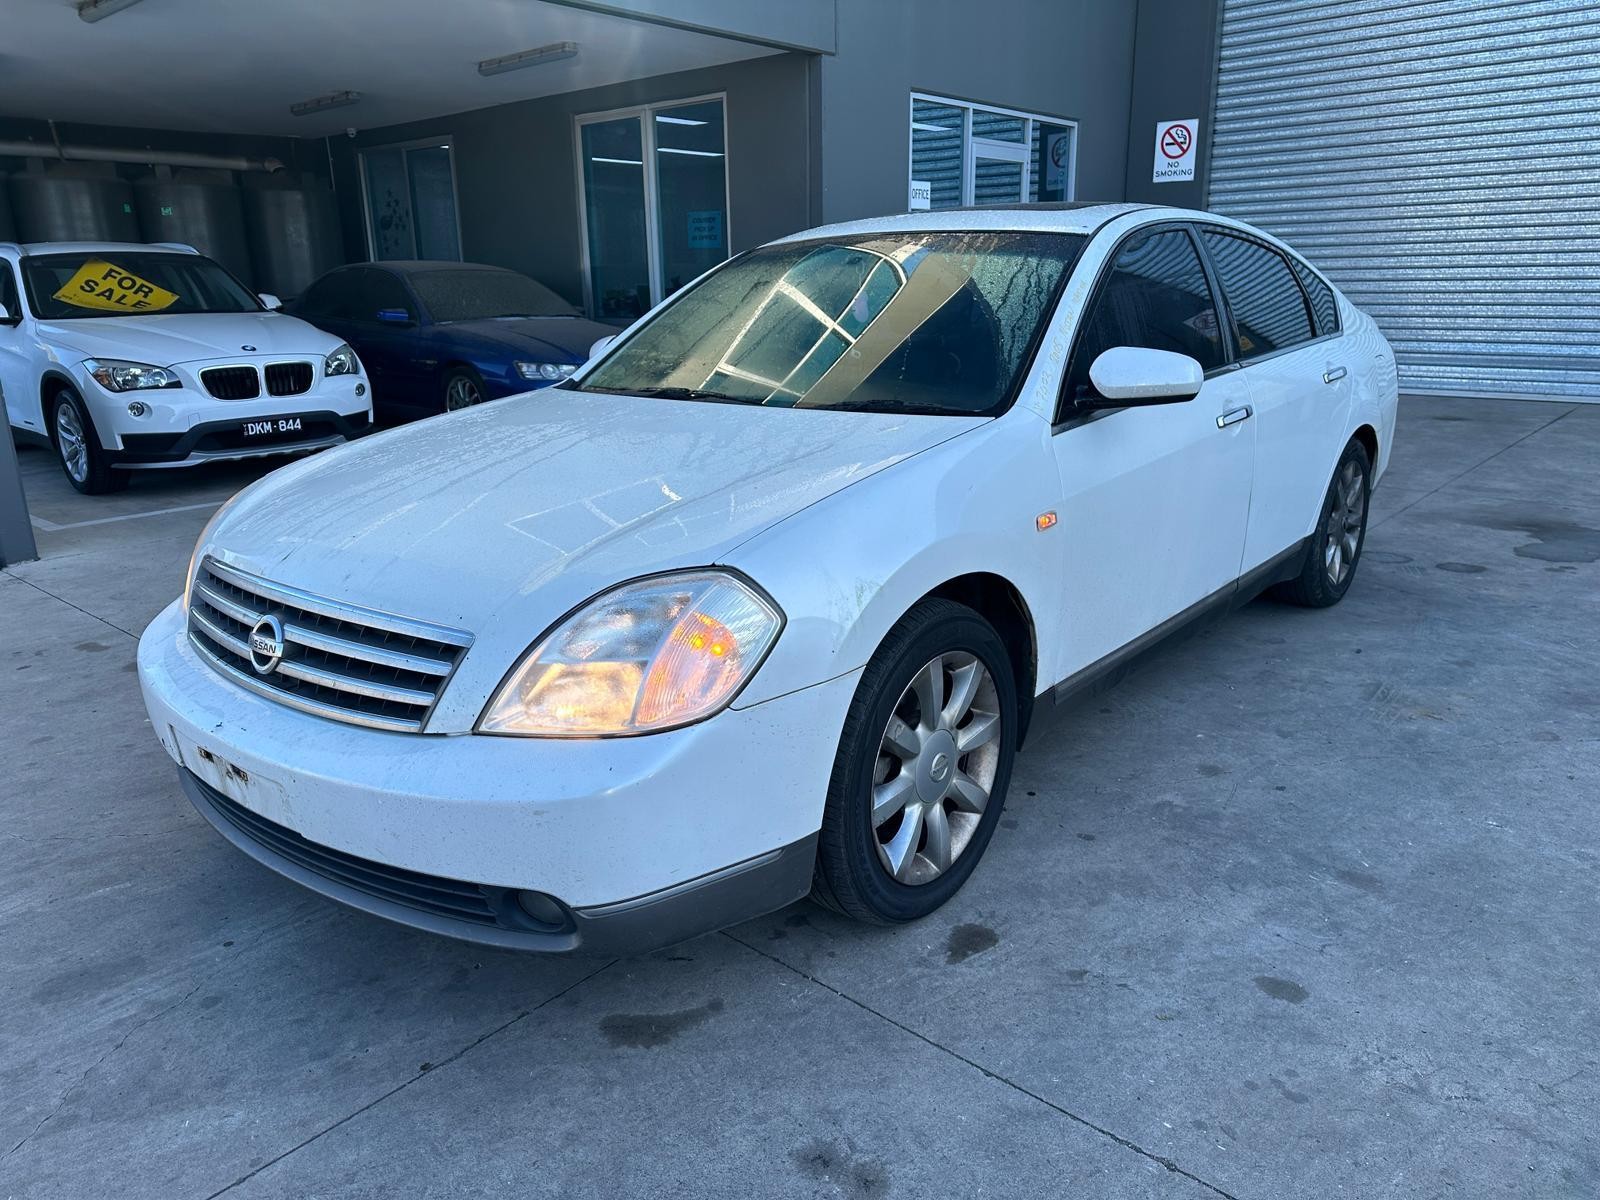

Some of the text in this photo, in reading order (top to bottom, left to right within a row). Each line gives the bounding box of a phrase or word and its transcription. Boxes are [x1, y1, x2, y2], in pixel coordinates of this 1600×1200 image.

[1155, 169, 1192, 178] SMOKING
[912, 188, 929, 200] OFFICE
[101, 267, 154, 299] FOR
[79, 278, 152, 309] SALE
[252, 637, 277, 654] SSAN
